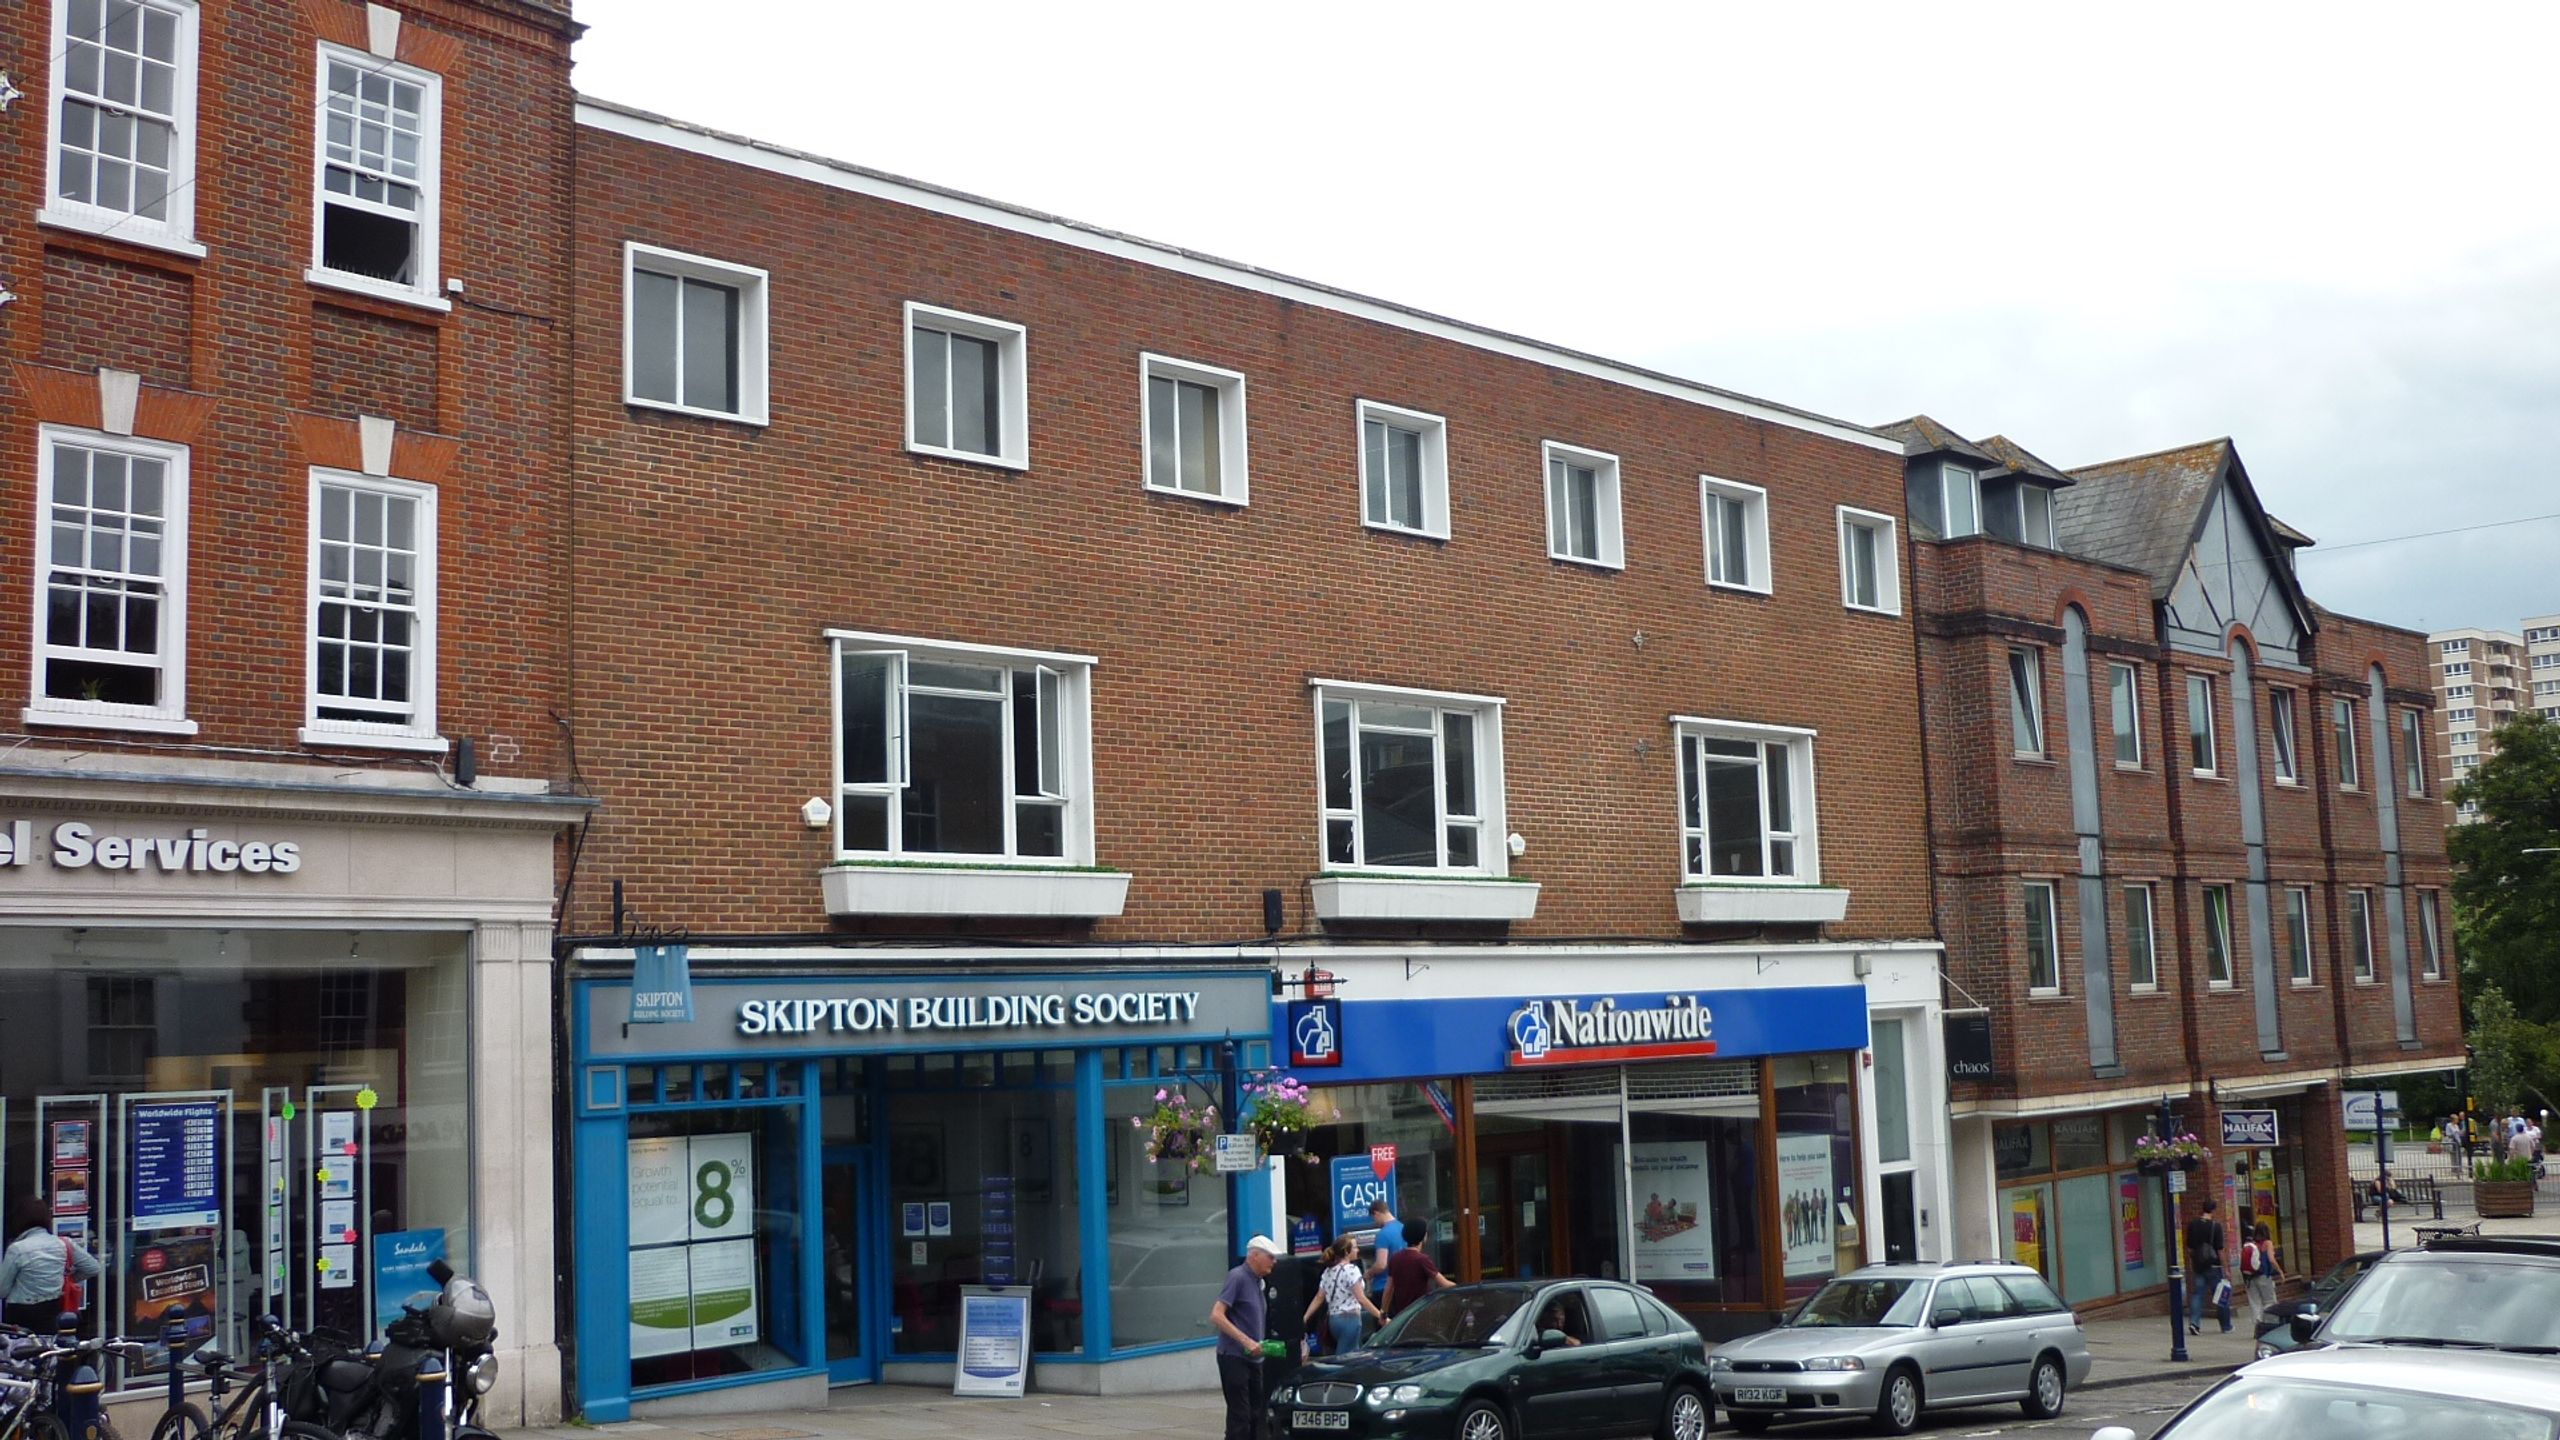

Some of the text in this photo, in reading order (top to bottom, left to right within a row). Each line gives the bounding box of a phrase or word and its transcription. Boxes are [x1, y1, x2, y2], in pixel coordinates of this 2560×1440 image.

[53, 821, 300, 873] Services
[636, 992, 683, 1007] SKIPTON
[633, 1009, 685, 1018] BUILDING SOCIETY
[738, 992, 1200, 1034] SKIPTON BUILDING SOCIETY
[1552, 995, 1713, 1045] Nationwide
[1953, 1060, 1990, 1073] chaos
[138, 1107, 212, 1118] Worldwide Flights
[2224, 1122, 2272, 1133] HALIFAX
[1371, 1146, 1395, 1161] FREE
[632, 1166, 672, 1178] Growth
[632, 1179, 678, 1196] potential
[1341, 1181, 1387, 1208] CASH
[632, 1197, 663, 1209] equal
[394, 1242, 427, 1255] Sandals
[1737, 1389, 1760, 1400] R132
[1294, 1413, 1347, 1427] Y346 BPG
